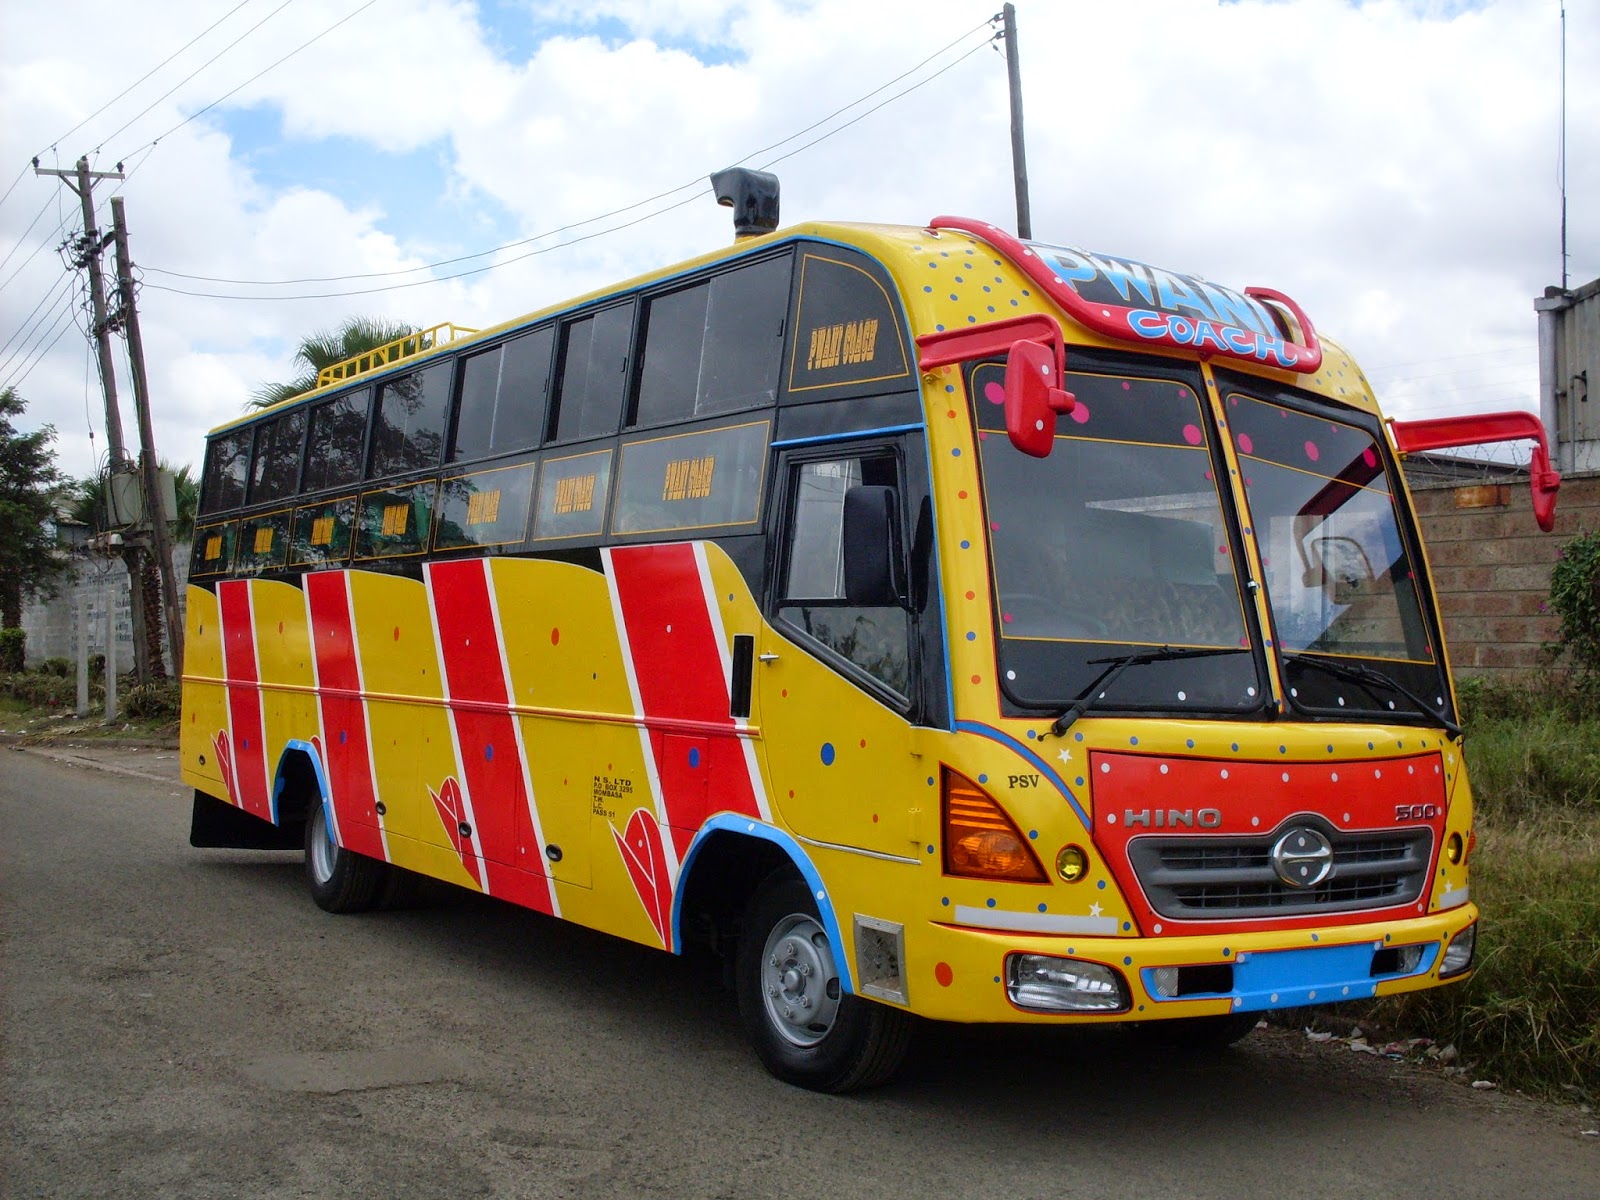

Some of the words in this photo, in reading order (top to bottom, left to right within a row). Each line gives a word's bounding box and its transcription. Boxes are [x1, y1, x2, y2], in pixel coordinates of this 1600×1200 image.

[1029, 245, 1284, 339] PWANI
[1127, 309, 1298, 367] COACH
[614, 778, 631, 786] LTD
[1008, 774, 1039, 789] PSV
[594, 789, 623, 798] MOMBASA
[593, 808, 607, 816] PASS
[1124, 808, 1222, 828] HINO
[1395, 803, 1436, 821] 500
